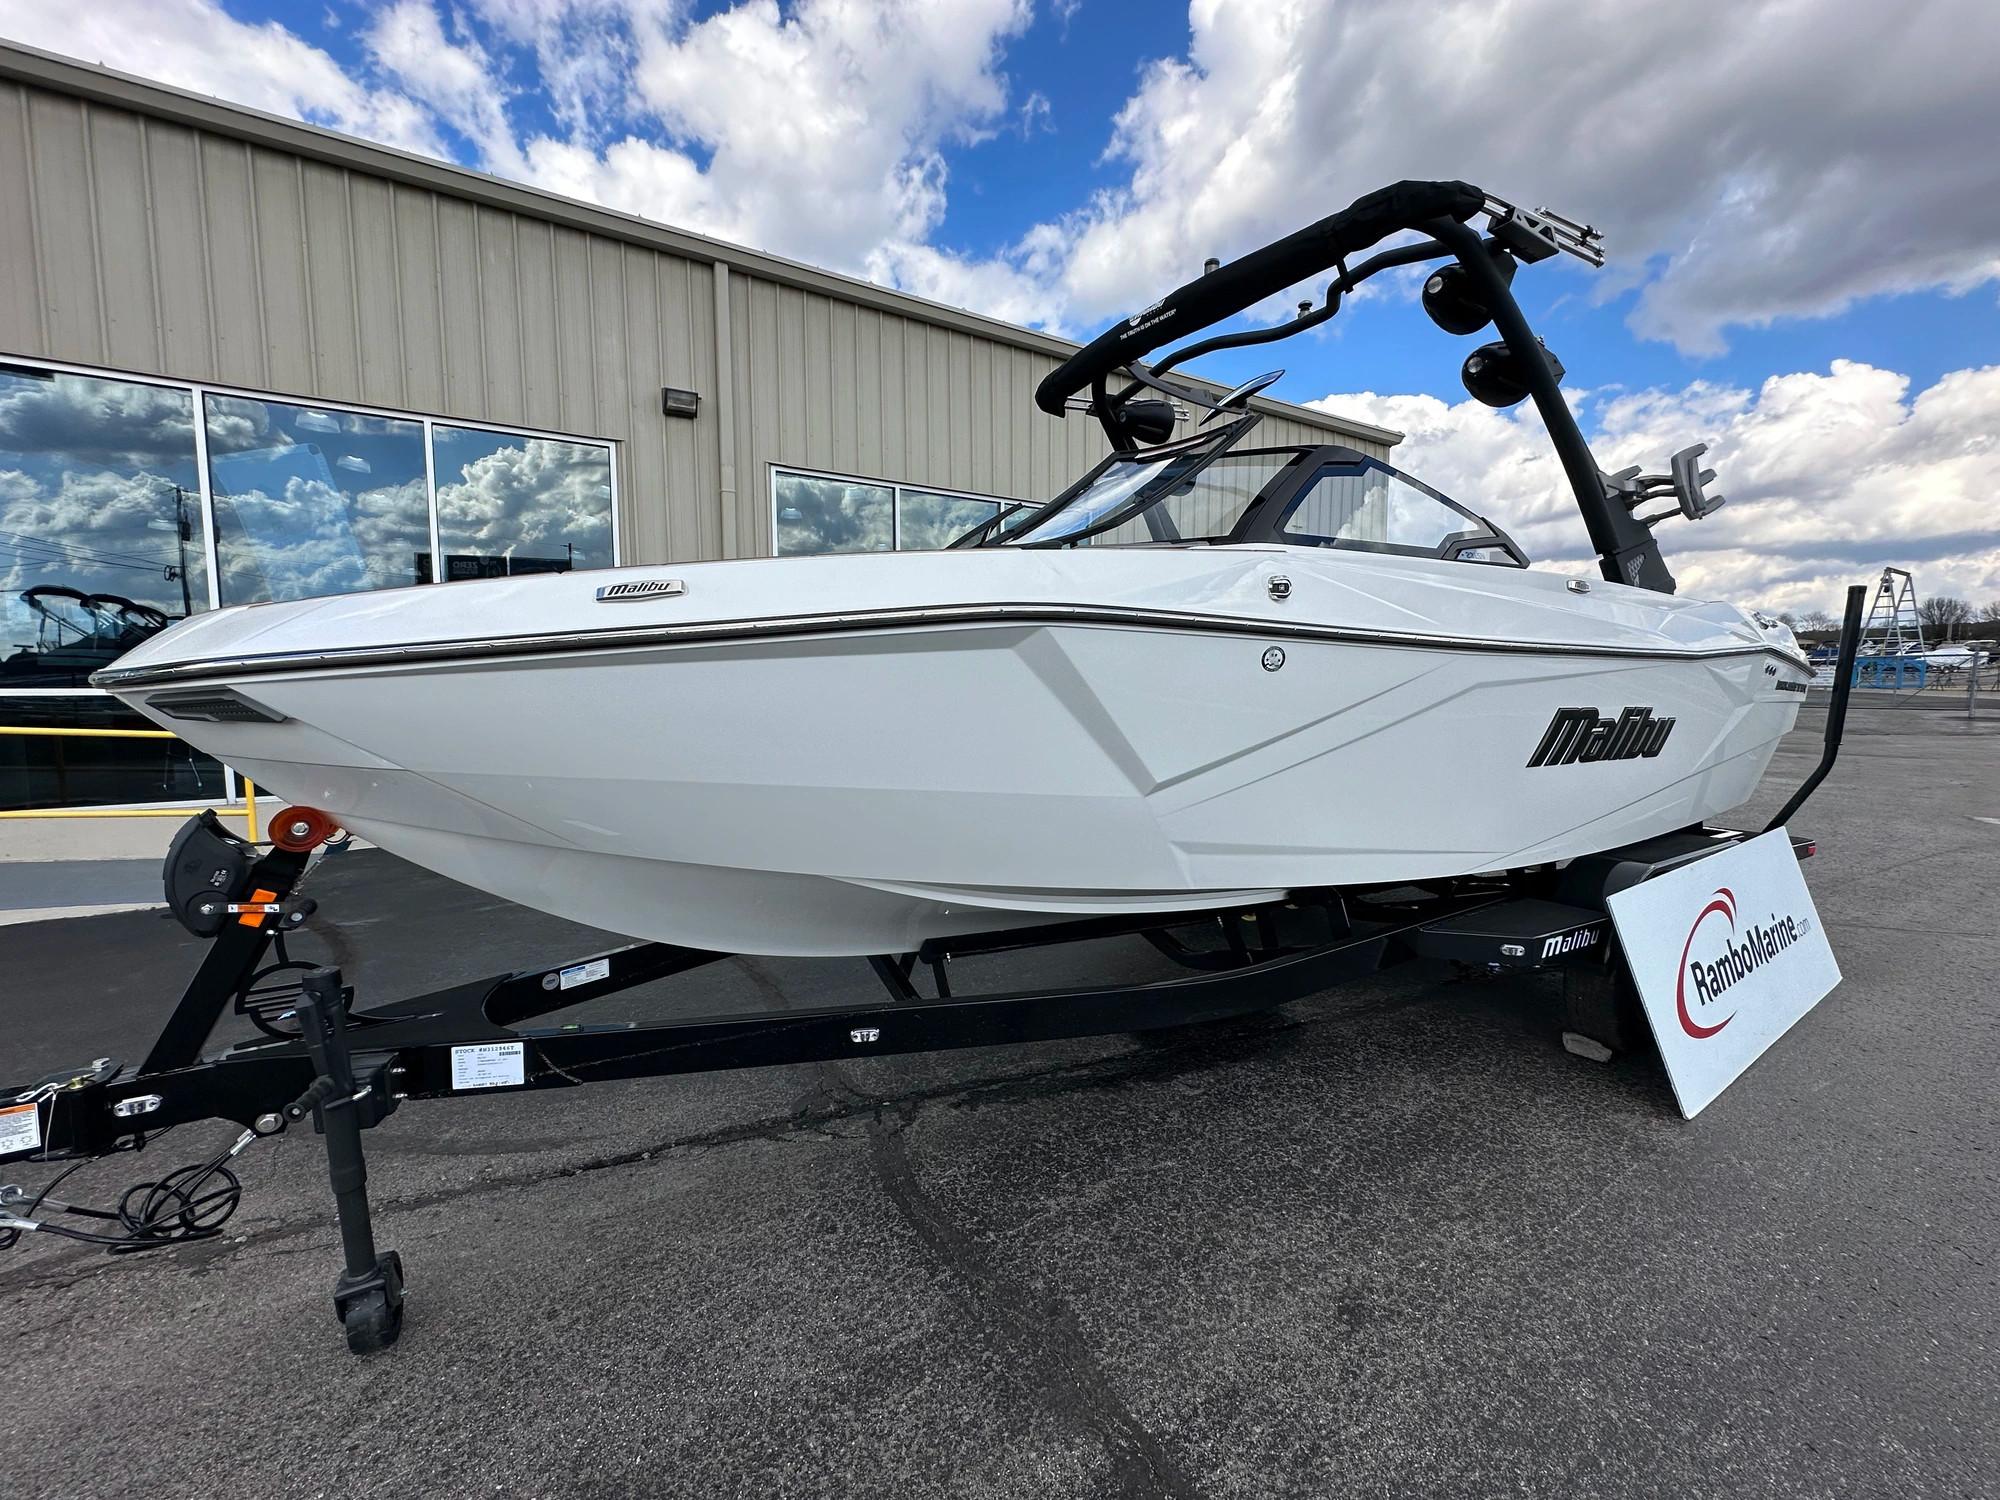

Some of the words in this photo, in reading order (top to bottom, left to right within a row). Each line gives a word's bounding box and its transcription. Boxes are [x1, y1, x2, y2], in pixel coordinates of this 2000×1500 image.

[607, 581, 671, 596] Malibu
[1526, 706, 1676, 768] Malibu
[1541, 928, 1600, 959] Malibu
[1690, 912, 1811, 1006] RamboMarine.com
